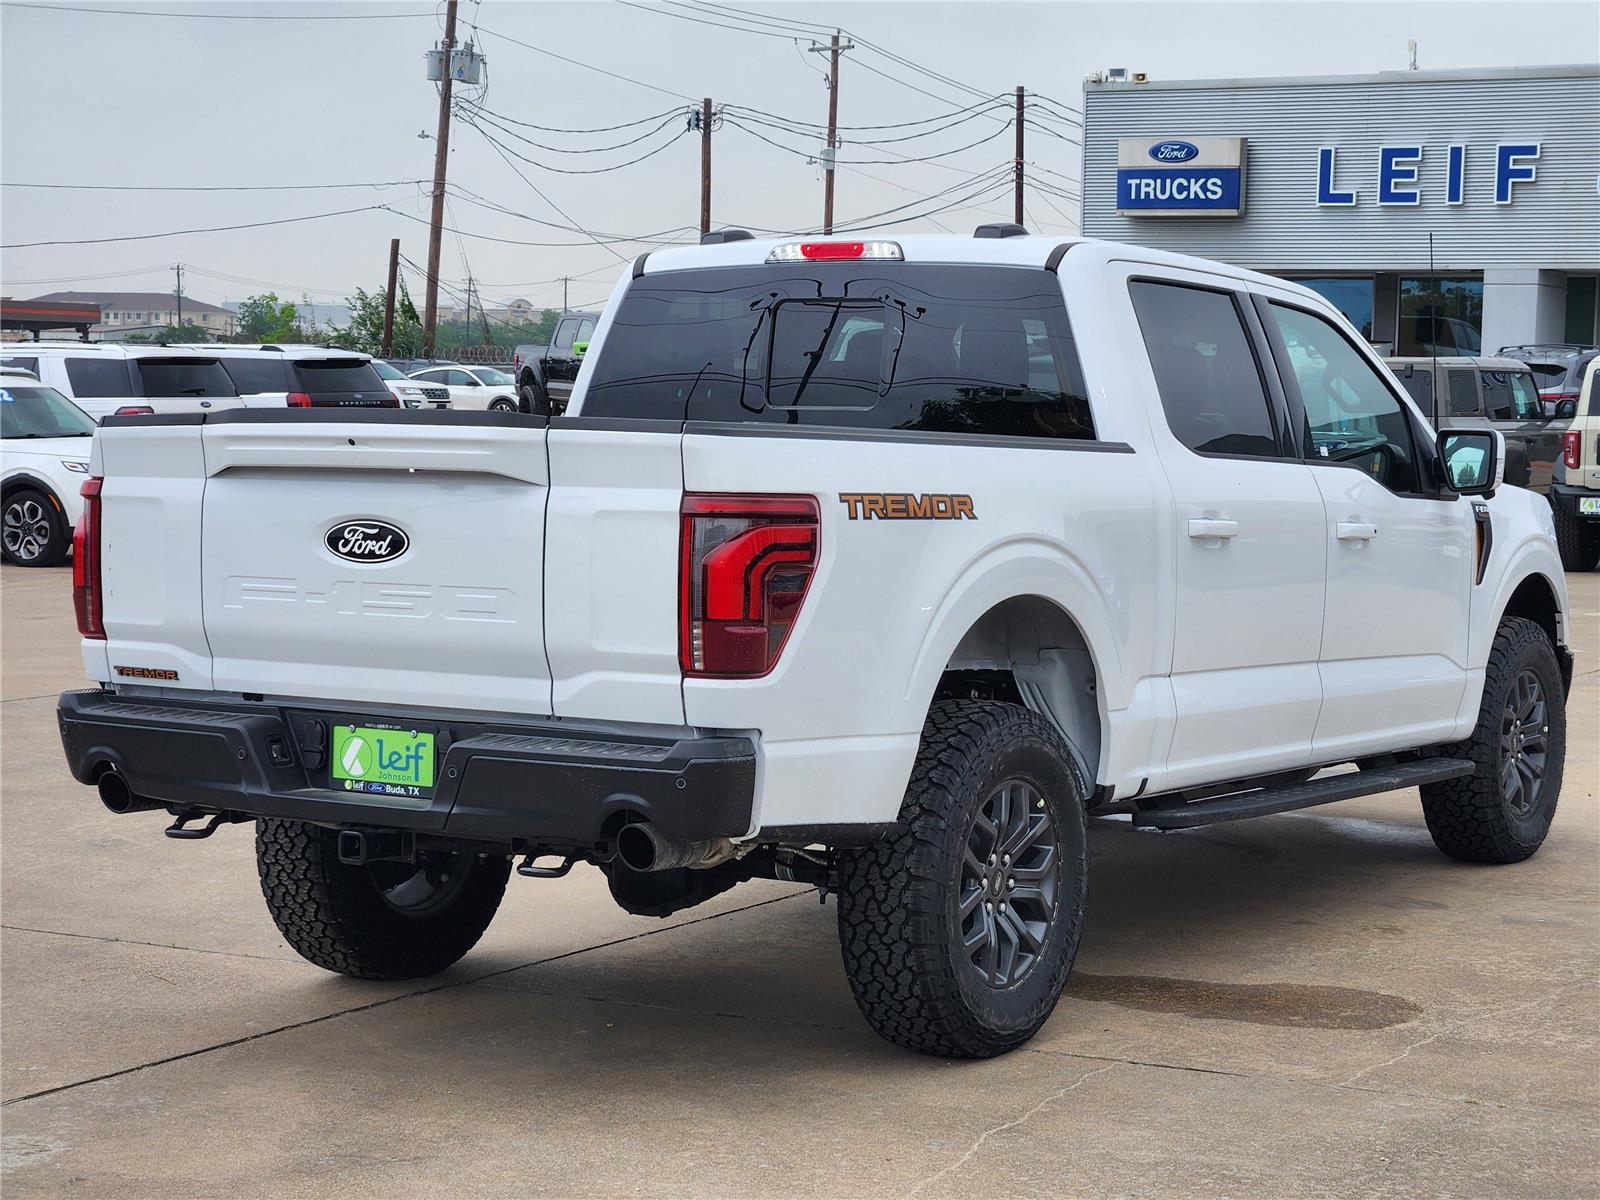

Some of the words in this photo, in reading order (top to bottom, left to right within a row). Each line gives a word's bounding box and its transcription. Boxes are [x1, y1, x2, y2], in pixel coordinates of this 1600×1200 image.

[1317, 143, 1541, 206] LEIF
[1127, 177, 1223, 200] TRUCKS
[838, 492, 978, 521] TREMOR
[113, 665, 180, 681] TREMOR
[377, 771, 412, 782] Johnson
[386, 784, 407, 796] Buda,
[408, 786, 420, 796] TX
